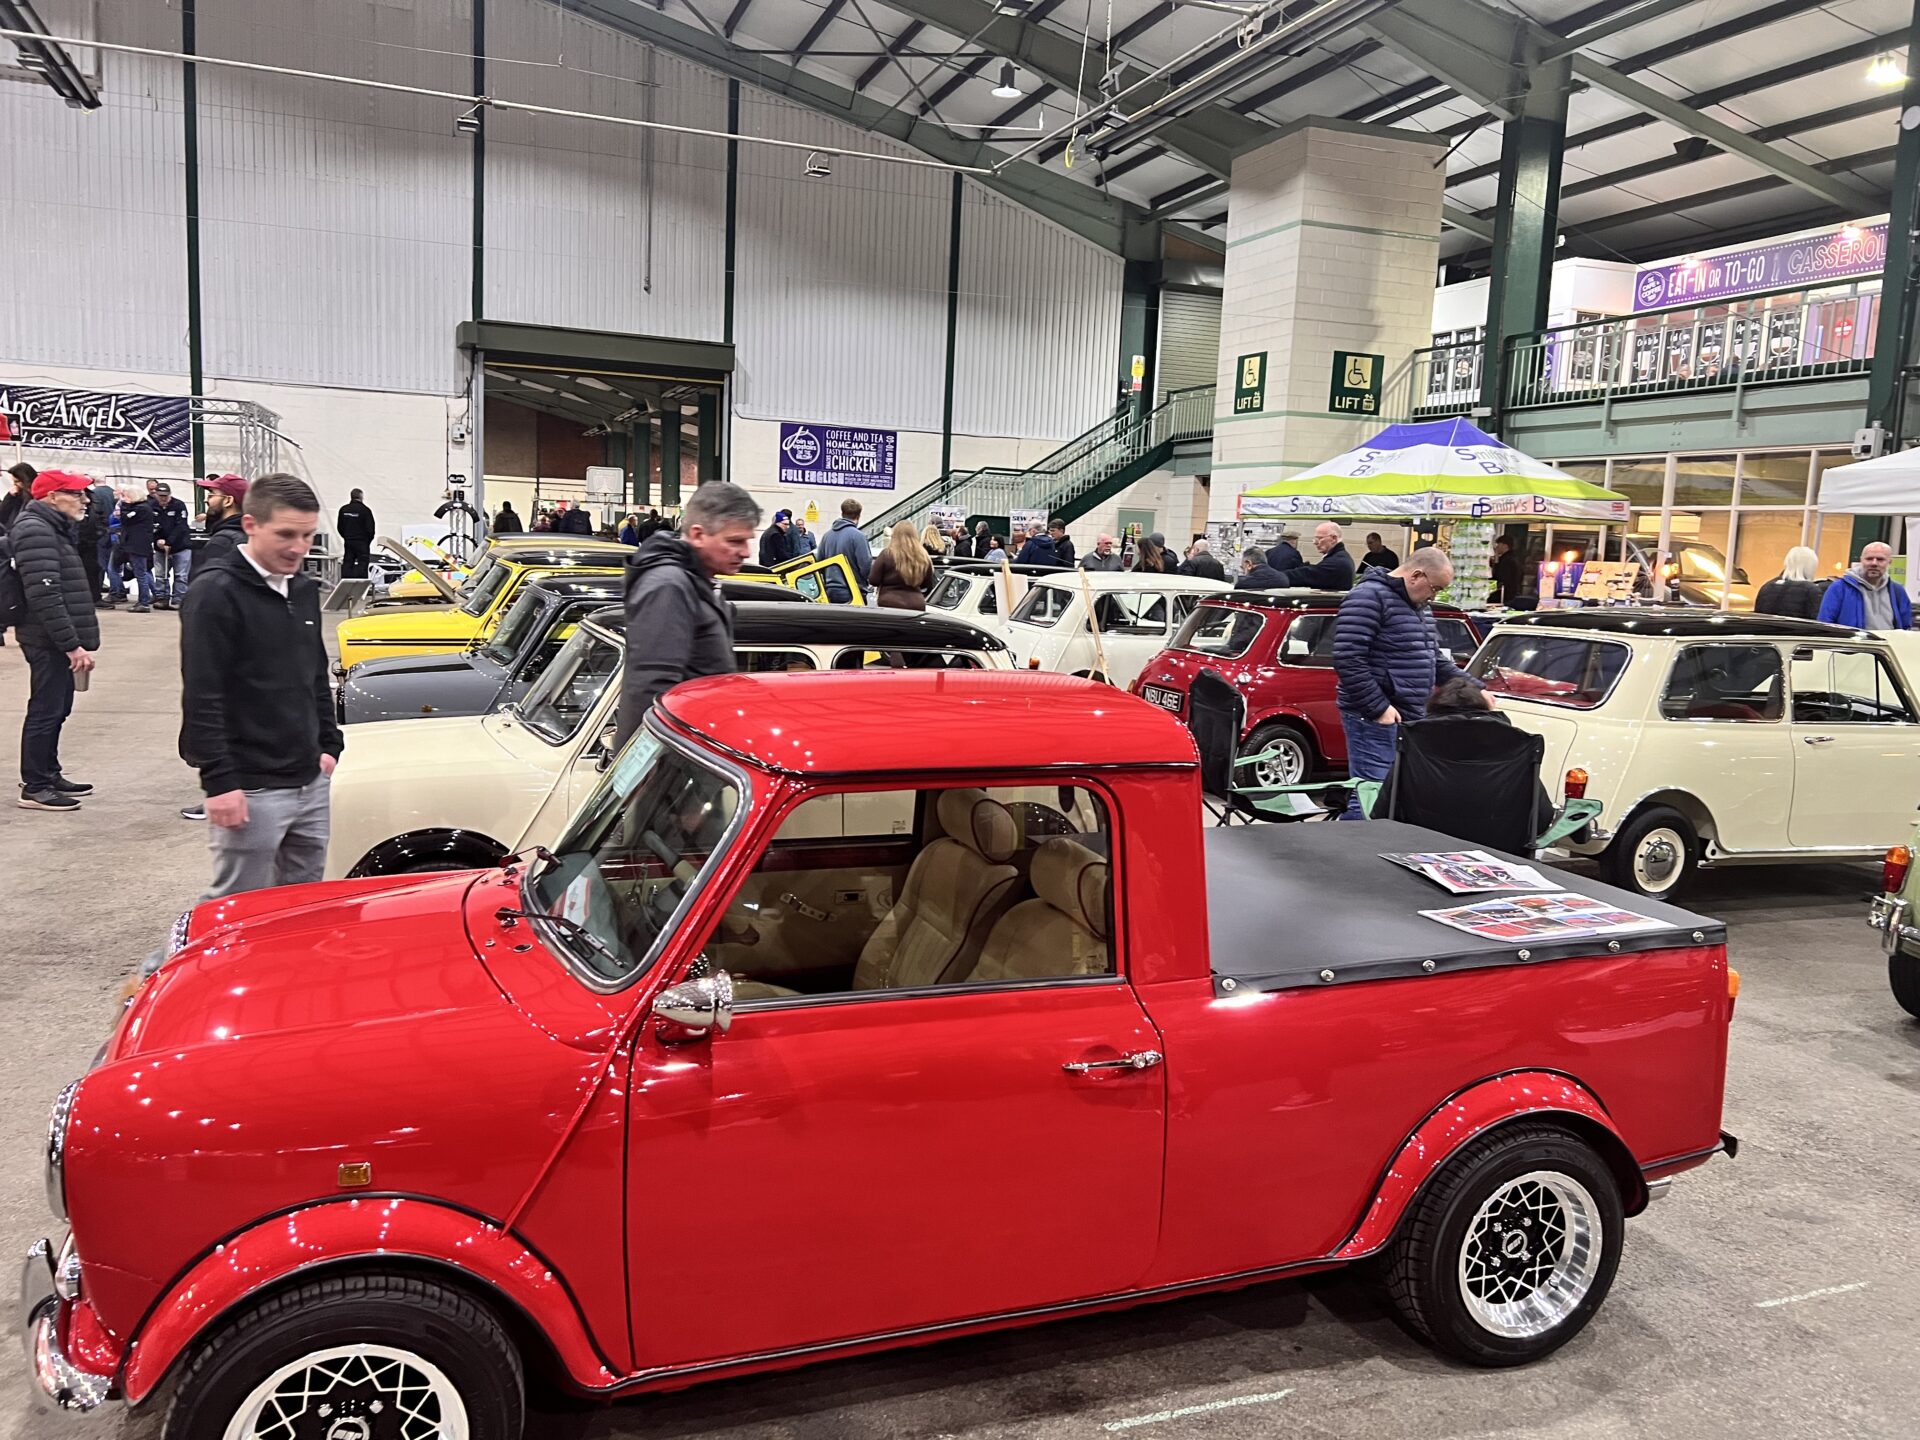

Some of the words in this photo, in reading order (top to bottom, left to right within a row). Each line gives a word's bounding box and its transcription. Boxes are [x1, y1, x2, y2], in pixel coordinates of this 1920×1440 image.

[1668, 266, 1707, 297] EAT-IN
[1709, 269, 1722, 289] OR
[1725, 256, 1766, 287] TO-GO
[1237, 397, 1253, 410] LIFT
[1335, 396, 1360, 410] LIFT
[49, 394, 126, 435] ANGELS
[826, 430, 851, 441] COFFEE
[853, 431, 868, 443] AND
[870, 433, 883, 444] TEA
[886, 435, 895, 451] TO-GO
[826, 440, 877, 451] HOMEMADE
[832, 455, 877, 473] CHICKEN
[884, 457, 894, 474] EAT-IN
[781, 469, 803, 482] FULL
[804, 470, 845, 485] ENGLISH
[1478, 496, 1528, 514] Smiffy's
[1533, 495, 1559, 513] Bits
[1145, 687, 1161, 704] NBU
